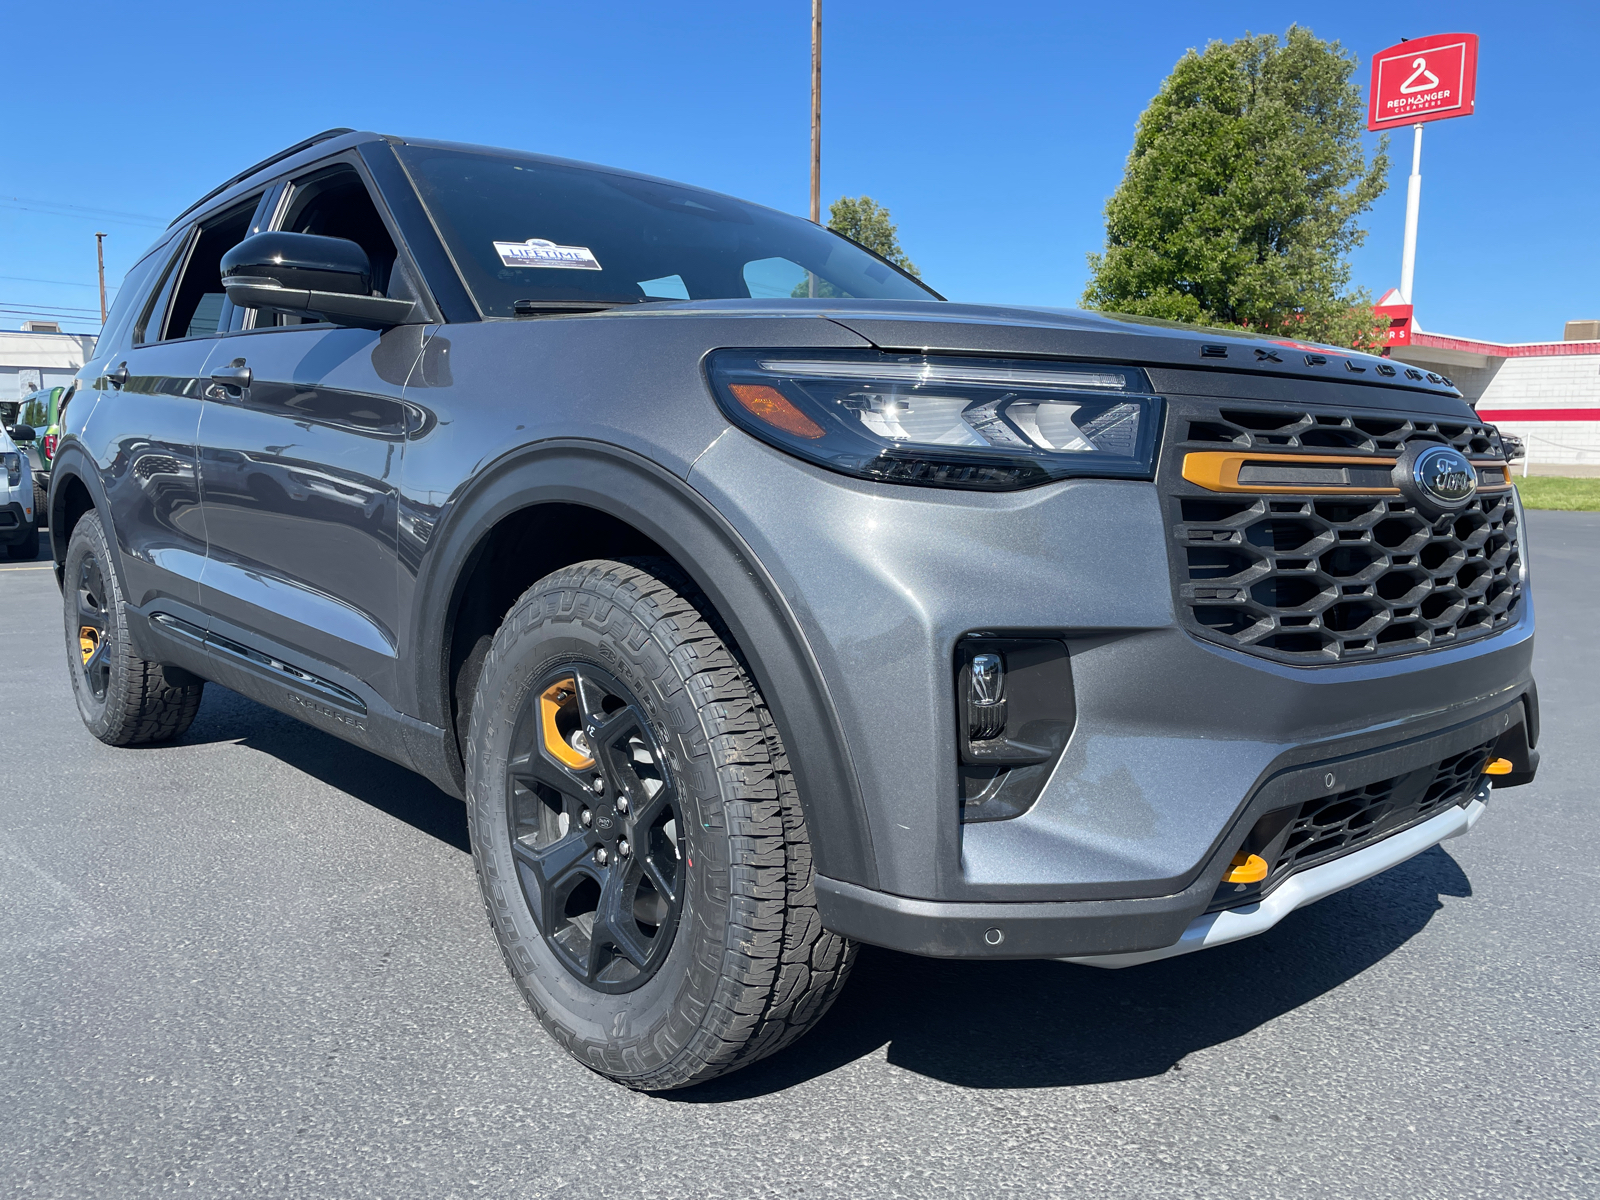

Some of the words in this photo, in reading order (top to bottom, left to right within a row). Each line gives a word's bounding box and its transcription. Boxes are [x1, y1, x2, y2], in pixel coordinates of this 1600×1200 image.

[1387, 98, 1406, 108] RED
[1395, 100, 1441, 113] CLEANERS
[509, 248, 583, 260] LIFETIME
[1200, 344, 1455, 387] EXPLORER
[1436, 458, 1469, 491] Ford
[287, 693, 367, 731] EXPLORER
